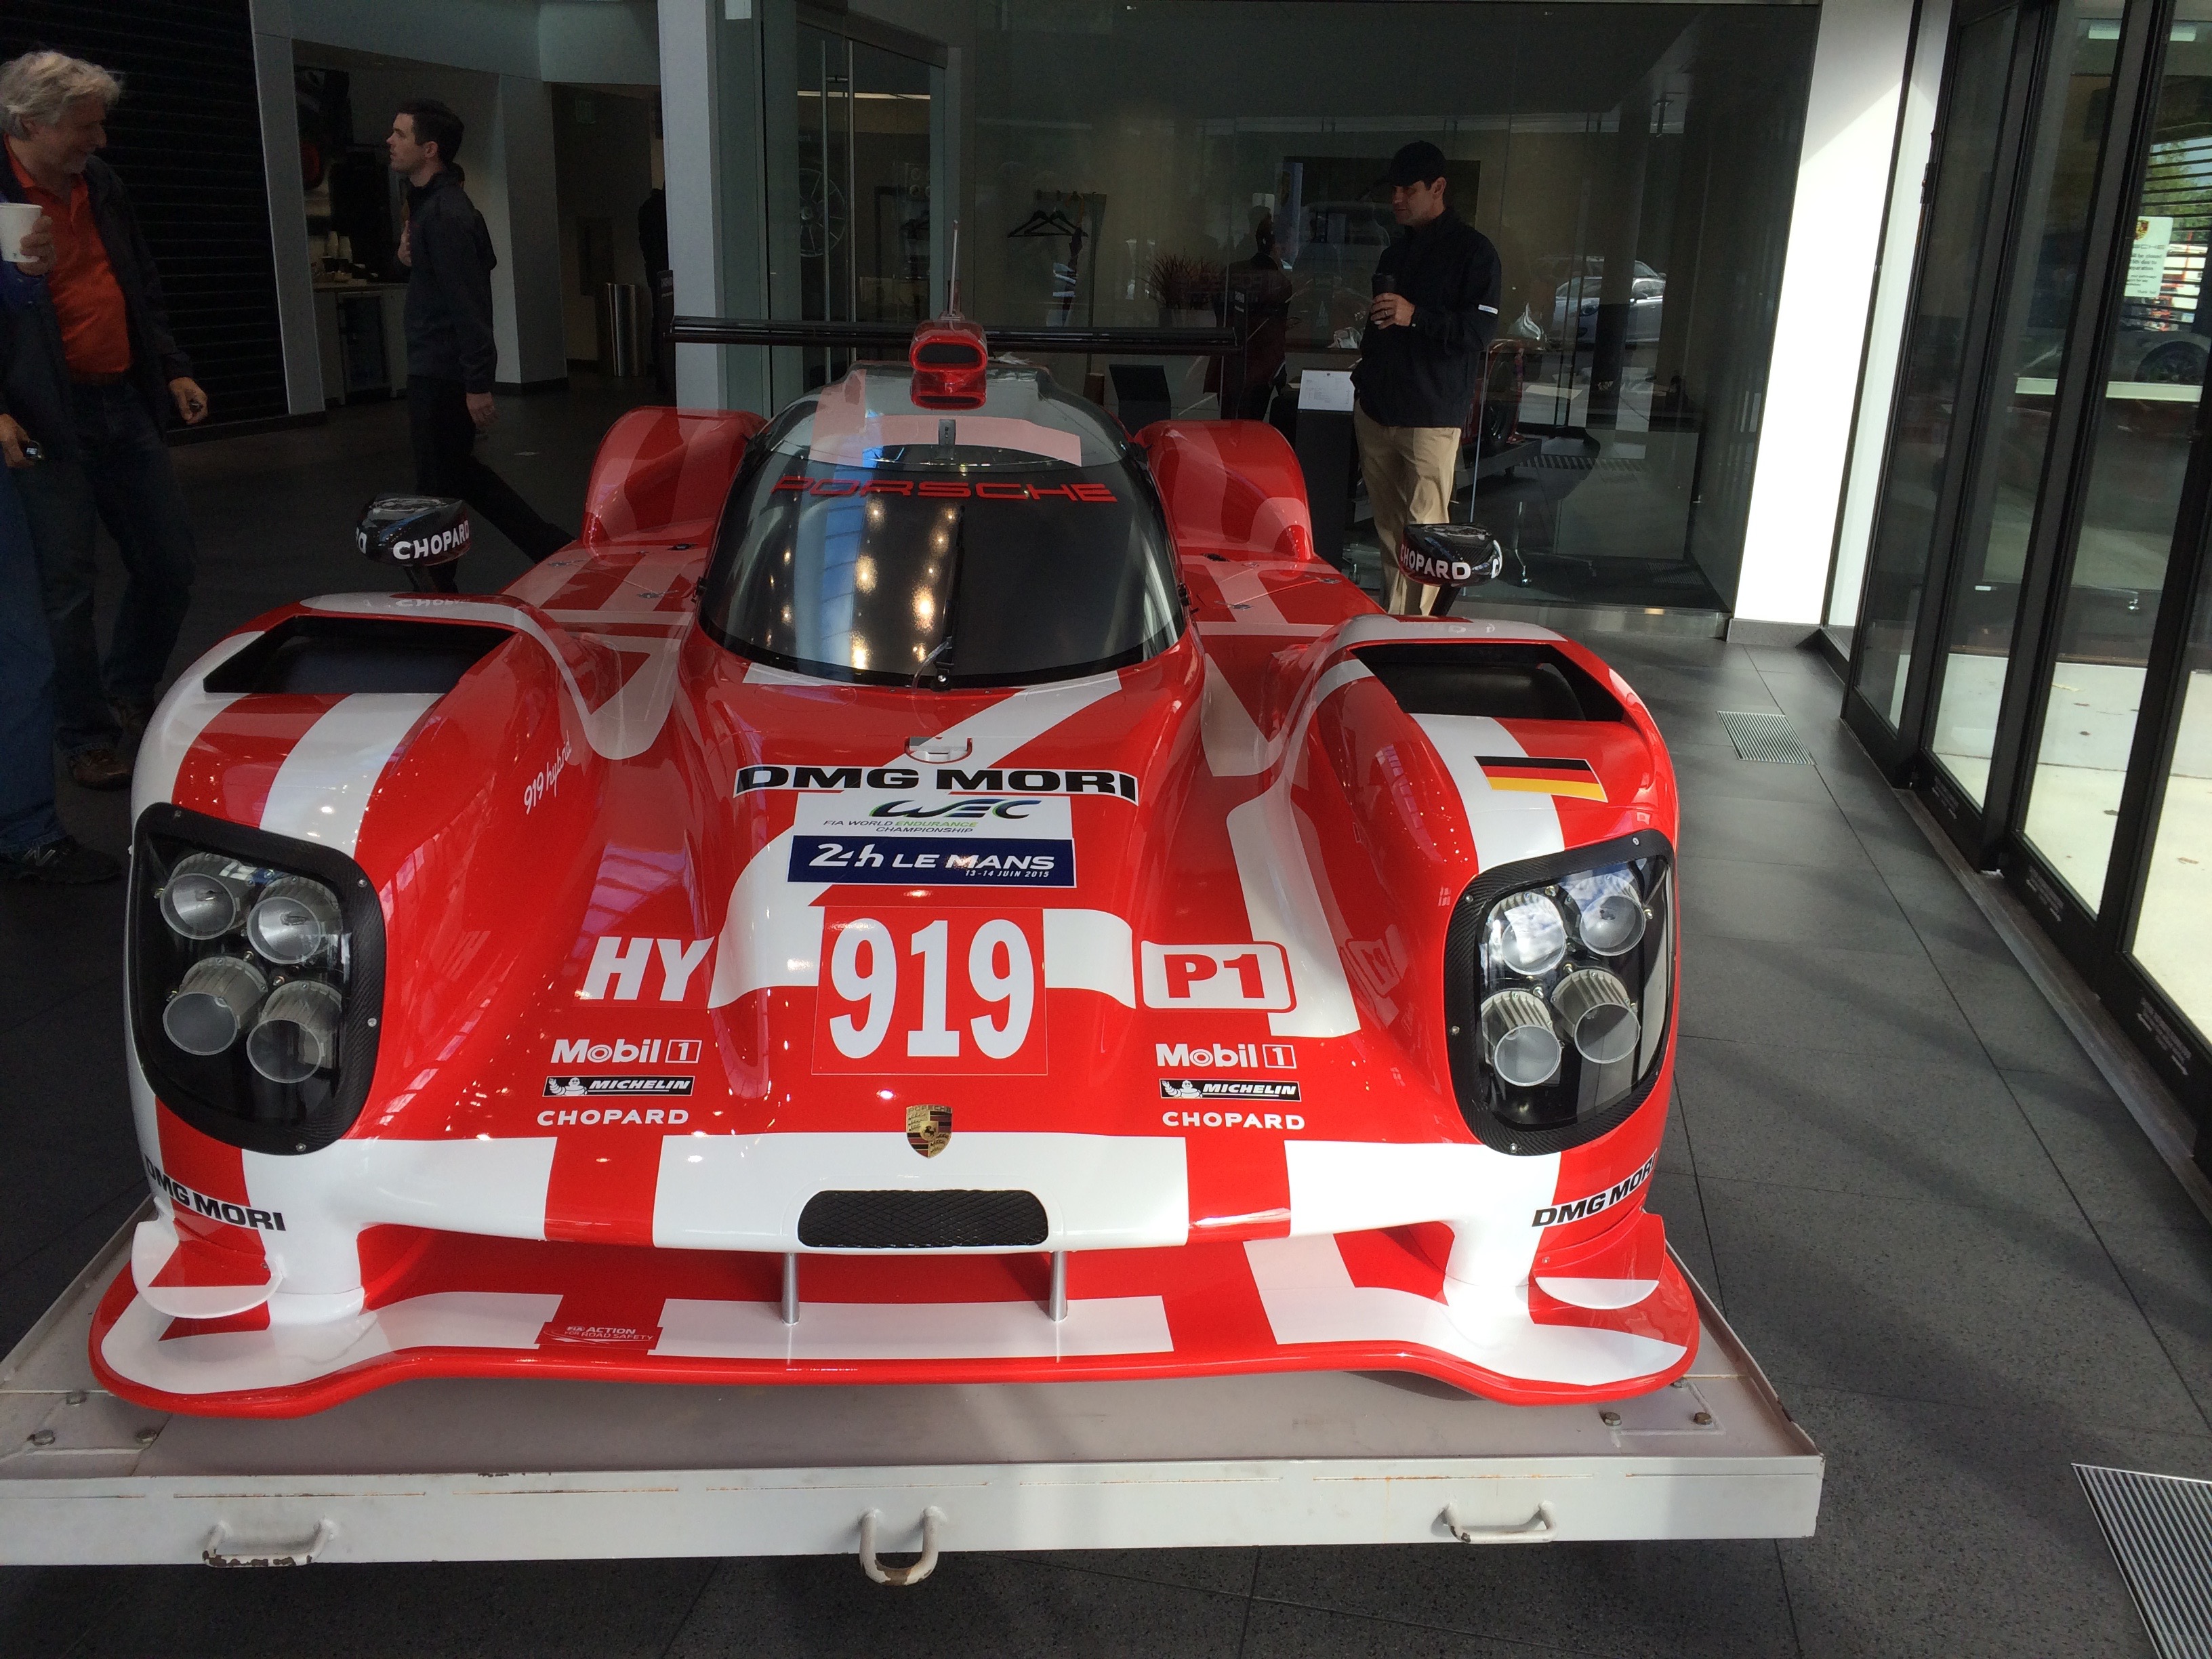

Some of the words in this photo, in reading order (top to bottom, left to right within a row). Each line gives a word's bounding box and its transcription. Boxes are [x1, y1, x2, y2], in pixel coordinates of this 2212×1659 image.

[770, 476, 1117, 502] PORSCHE
[393, 520, 470, 560] CHOPARD
[1401, 544, 1471, 580] CHOPARD
[524, 772, 544, 815] 919
[546, 730, 572, 798] hybrid
[736, 766, 919, 794] DMG
[937, 769, 1136, 802] MORI
[869, 799, 1042, 819] WEC
[892, 853, 940, 868] LE
[945, 854, 1054, 870] MANS
[580, 936, 715, 1001] HY
[1164, 954, 1265, 998] P1
[830, 918, 1034, 1059] 919
[550, 1038, 661, 1063] Mobil
[1155, 1043, 1258, 1067] Mobil
[589, 1080, 691, 1089] MICHELIN
[1202, 1084, 1296, 1094] MICHELIN
[537, 1109, 689, 1126] CHOPARD
[1162, 1111, 1305, 1130] CHOPARD
[144, 1153, 190, 1206] DMG
[193, 1192, 286, 1231] MORI
[1532, 1193, 1606, 1227] DMG
[1609, 1152, 1656, 1205] MORI
